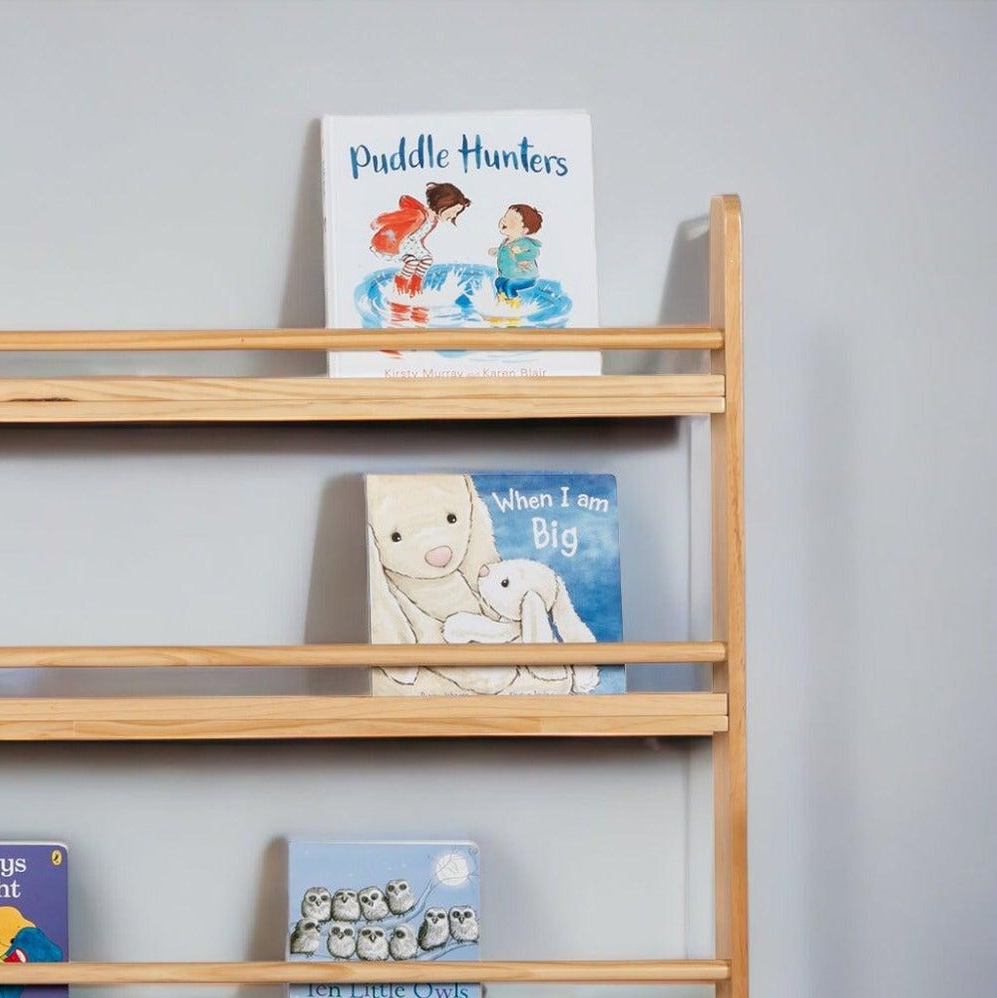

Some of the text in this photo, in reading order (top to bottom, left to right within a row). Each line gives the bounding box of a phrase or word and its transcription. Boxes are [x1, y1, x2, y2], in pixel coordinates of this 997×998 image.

[349, 134, 569, 180] Puddle Hunters
[491, 486, 610, 513] When I am
[531, 516, 580, 557] Big
